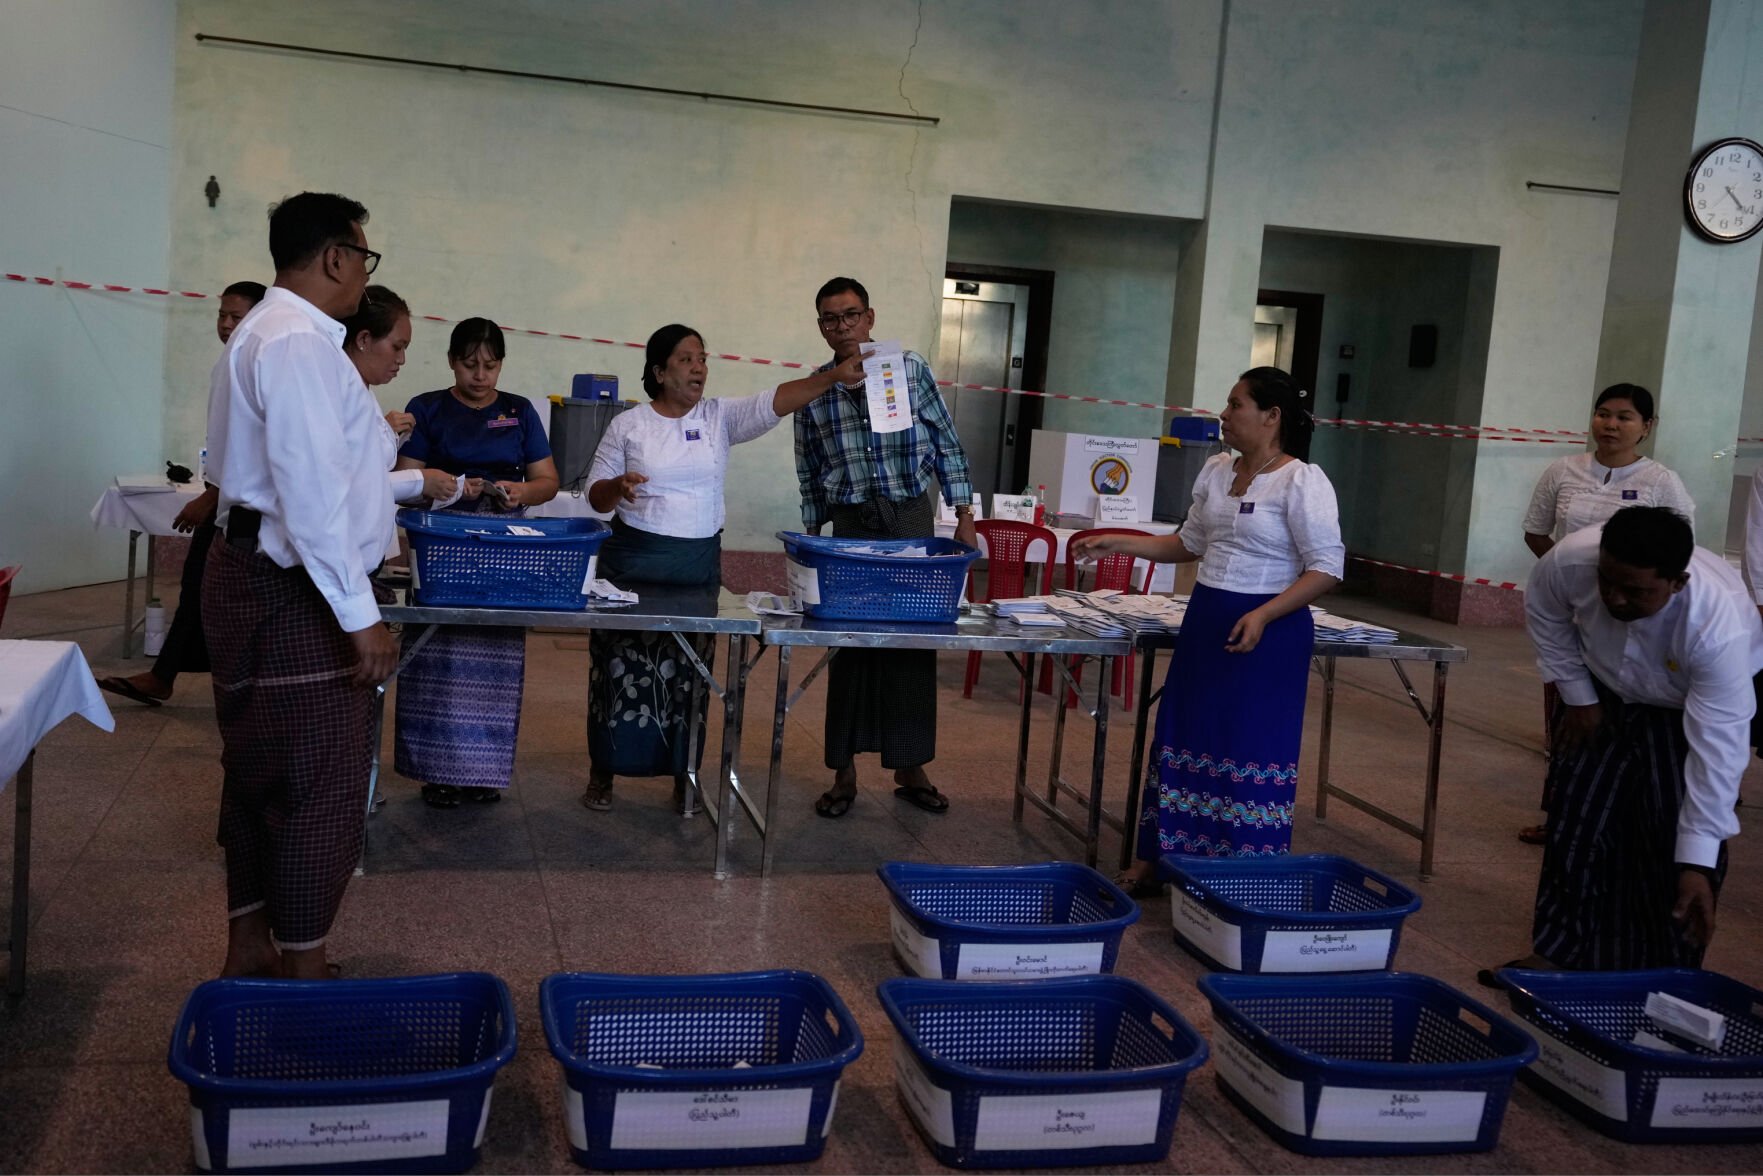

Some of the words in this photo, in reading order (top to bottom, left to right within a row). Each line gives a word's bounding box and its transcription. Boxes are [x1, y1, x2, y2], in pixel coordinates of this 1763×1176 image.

[1714, 156, 1724, 166] 11
[1729, 152, 1742, 163] 12
[1746, 159, 1751, 169] 1
[1702, 167, 1713, 178] 10
[1753, 172, 1762, 182] 2
[1696, 183, 1705, 193] 9
[1753, 189, 1762, 200] 3
[1697, 200, 1707, 210] 8
[1706, 213, 1715, 223] 7
[1734, 217, 1743, 227] 5
[1720, 218, 1729, 229] 6
